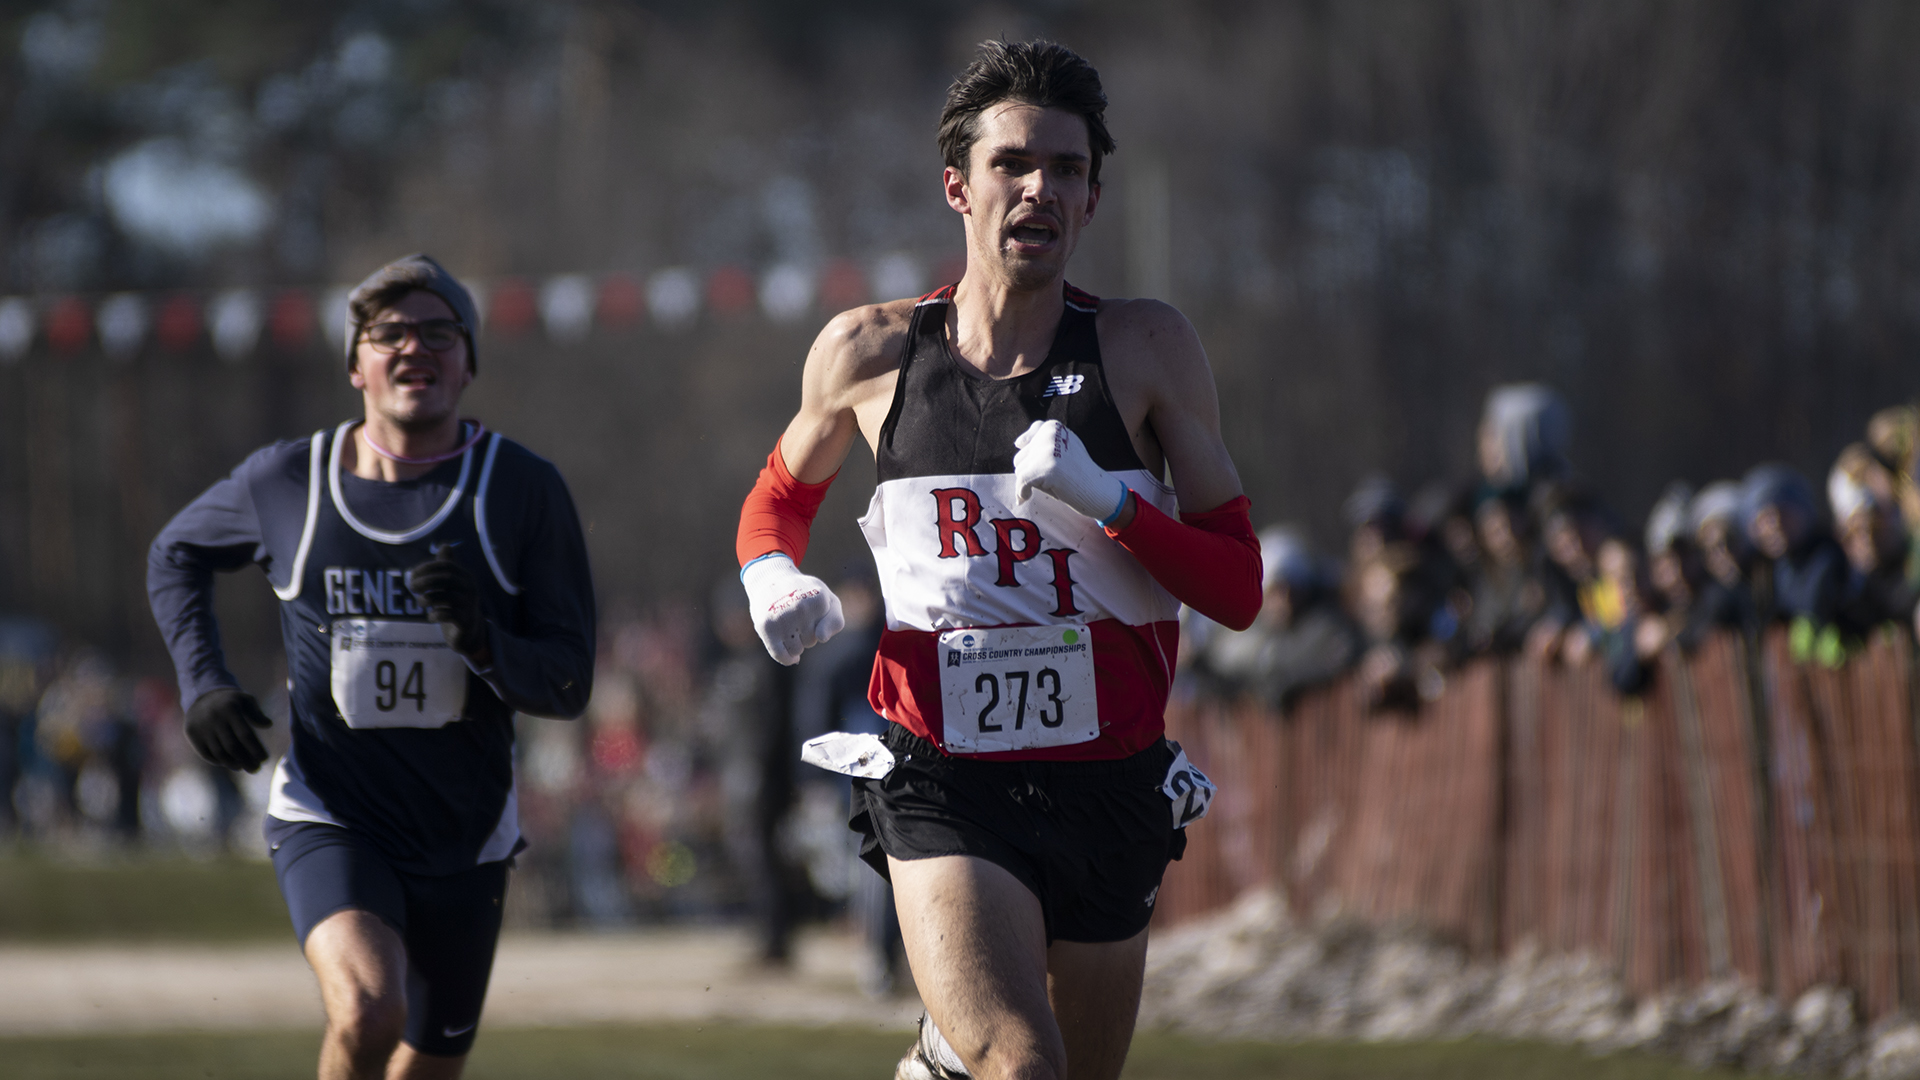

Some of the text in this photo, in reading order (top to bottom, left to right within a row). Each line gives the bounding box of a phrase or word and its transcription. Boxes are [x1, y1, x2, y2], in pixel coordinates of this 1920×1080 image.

[1043, 374, 1085, 397] NB
[930, 487, 1085, 617] RPI
[324, 566, 432, 616] GENES
[963, 651, 987, 661] CROSS
[989, 649, 1023, 659] COUNTRY
[1024, 643, 1087, 657] CHAMPIONSHIPS
[375, 660, 427, 713] 94
[975, 668, 1064, 733] 273
